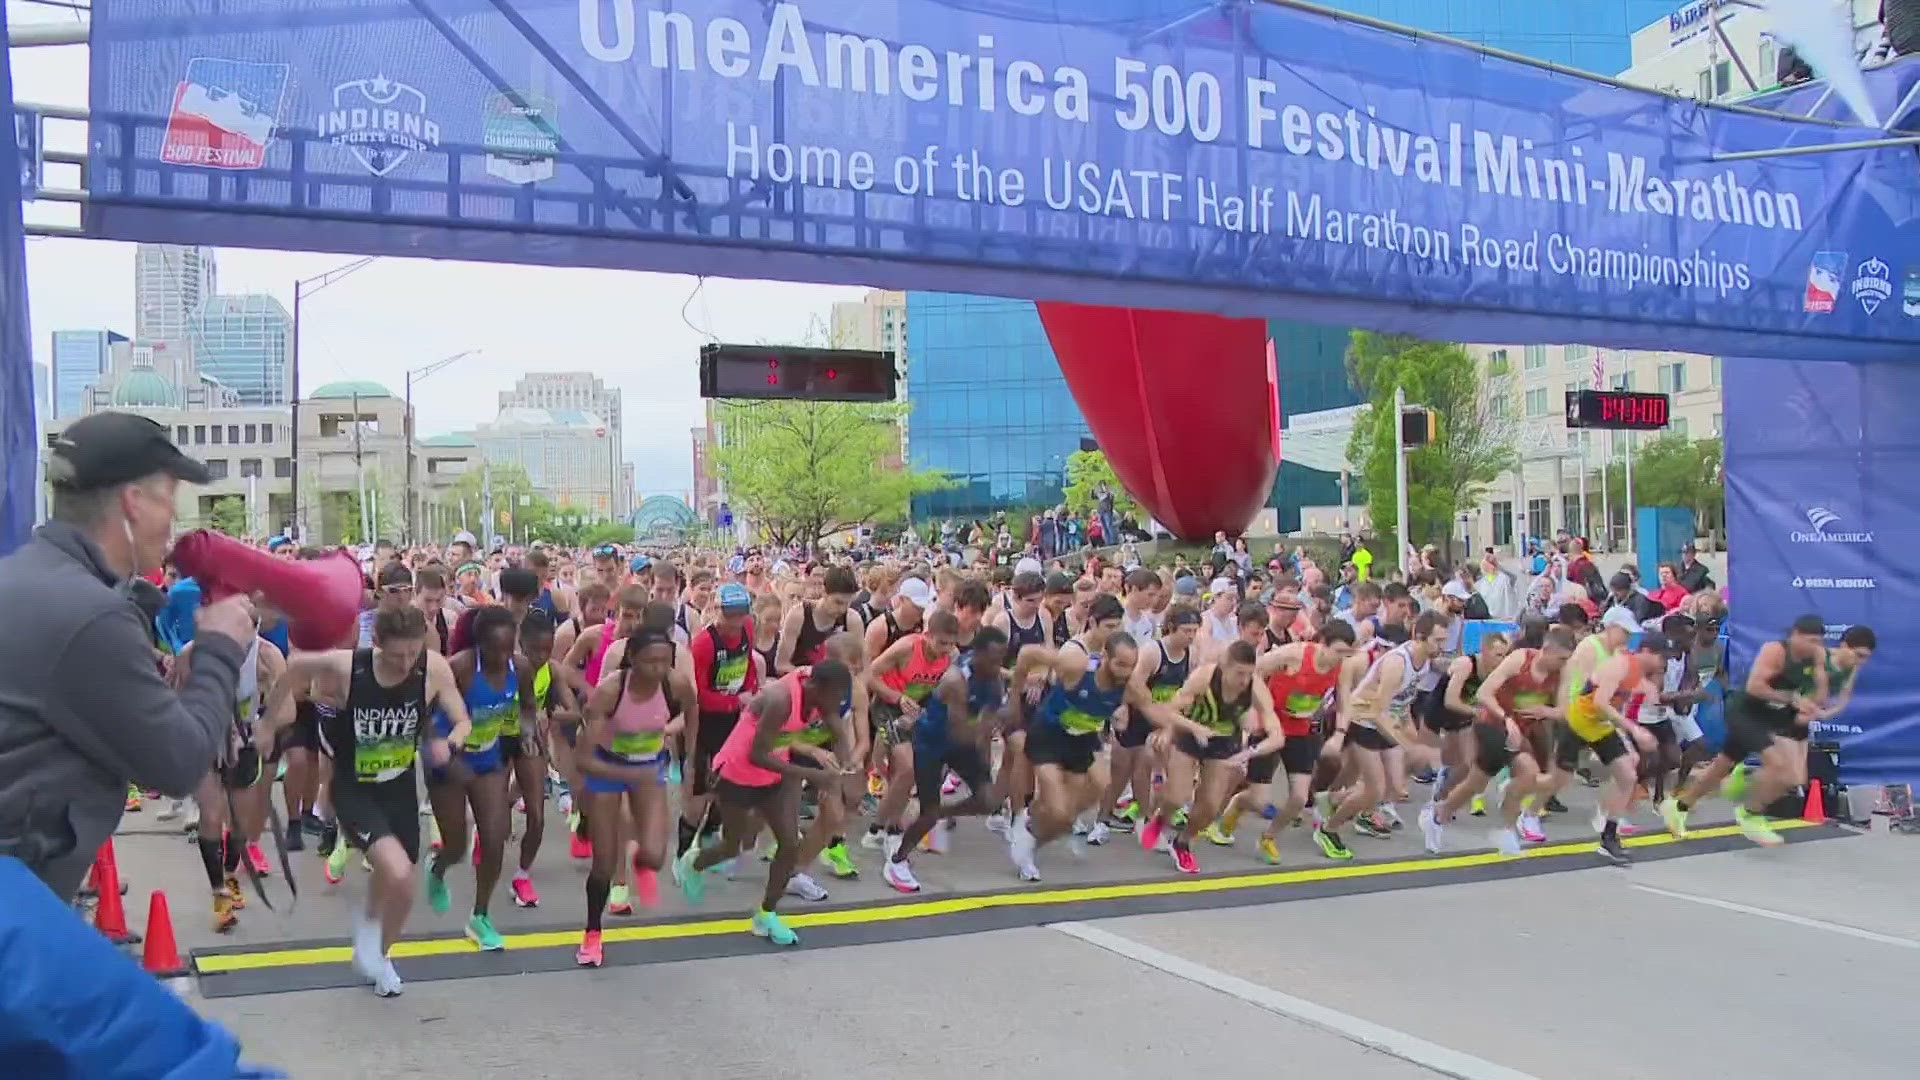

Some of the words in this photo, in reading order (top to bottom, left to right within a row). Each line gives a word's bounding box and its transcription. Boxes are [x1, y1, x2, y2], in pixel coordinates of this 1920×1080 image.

[579, 0, 1089, 122] OneAmerica
[1115, 57, 1221, 142] 500
[1247, 78, 1461, 186] Festival
[1475, 131, 1803, 231] Mini-Marathon
[318, 108, 440, 147] INDIANA
[167, 144, 193, 160] 500
[196, 146, 256, 165] FESTIVAL
[727, 121, 875, 191] Home
[894, 145, 939, 196] of
[952, 150, 1025, 206] the
[1043, 158, 1182, 221] USATF
[1197, 178, 1274, 233] Half
[1287, 190, 1450, 262] Marathon
[1461, 222, 1537, 272] Road
[1548, 231, 1750, 297] Championships
[1805, 578, 1834, 588] DELTA
[1835, 578, 1875, 588] DENTAL
[353, 706, 418, 721] INDIANA
[354, 719, 417, 737] ELITE
